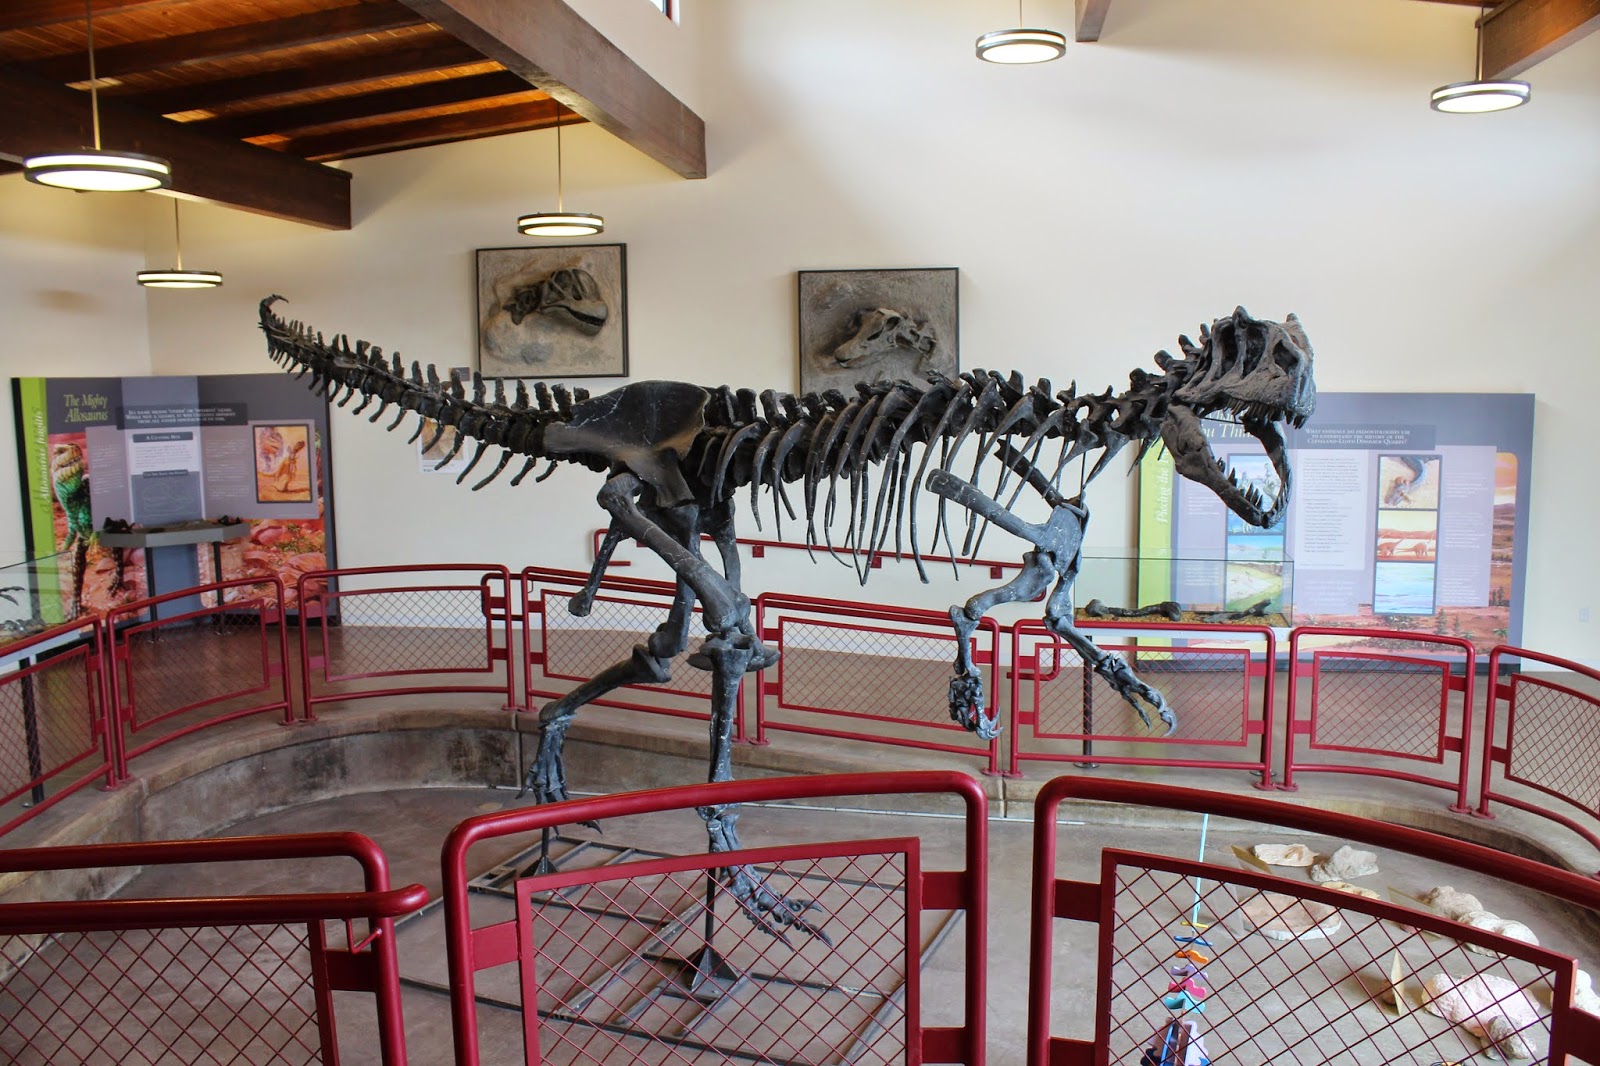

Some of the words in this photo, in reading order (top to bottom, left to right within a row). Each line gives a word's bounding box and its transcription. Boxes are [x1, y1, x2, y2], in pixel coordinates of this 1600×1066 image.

[64, 394, 80, 406] The
[82, 393, 108, 408] Mighty
[64, 408, 108, 422] Allosaurus
